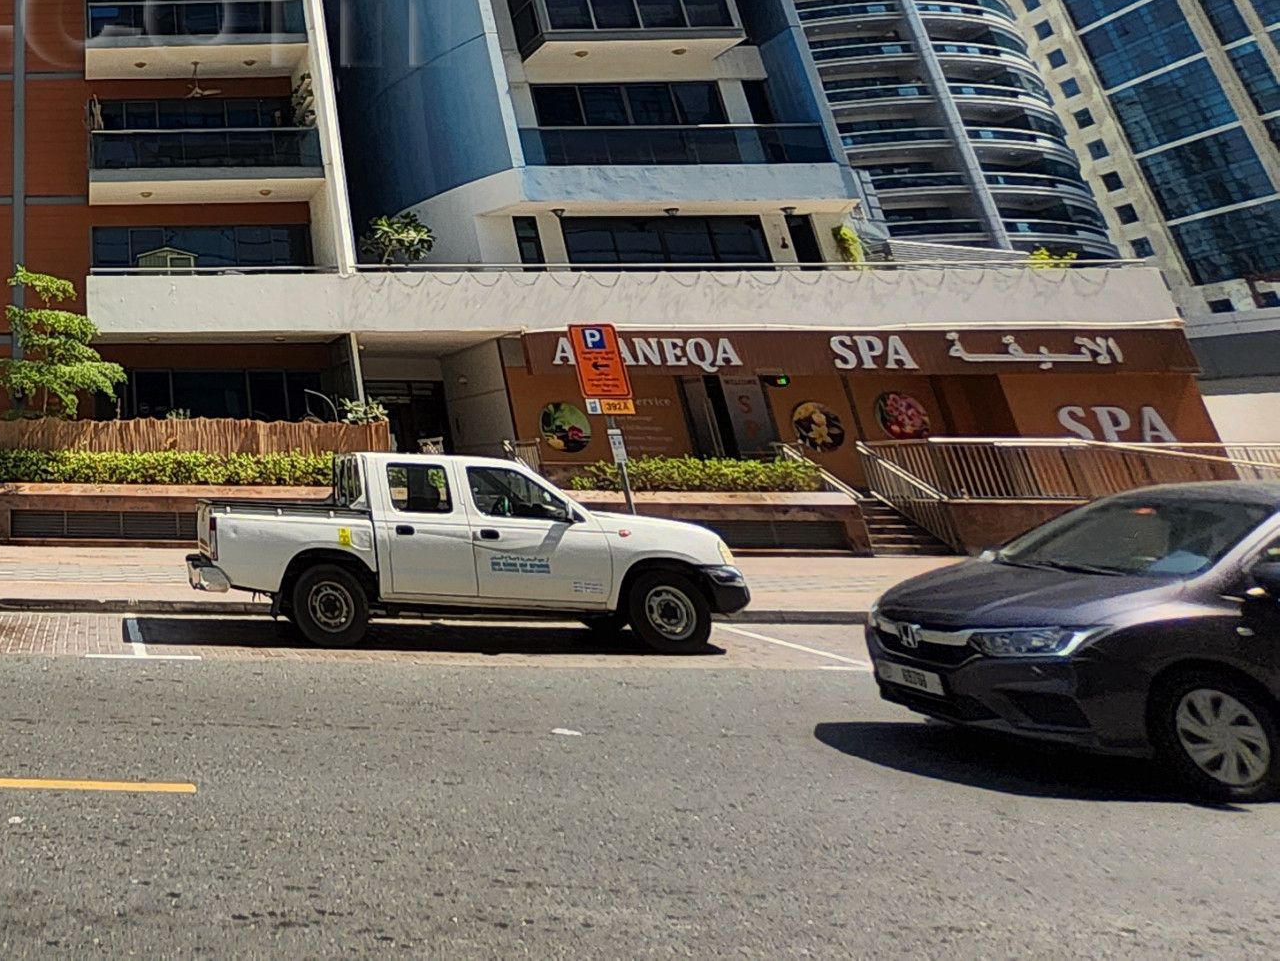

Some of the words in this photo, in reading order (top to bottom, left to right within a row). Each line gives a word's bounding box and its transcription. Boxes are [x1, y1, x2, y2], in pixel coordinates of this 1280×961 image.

[583, 329, 601, 348] P
[830, 335, 920, 370] SPA
[632, 397, 672, 407] ervice
[1057, 405, 1178, 443] SPA
